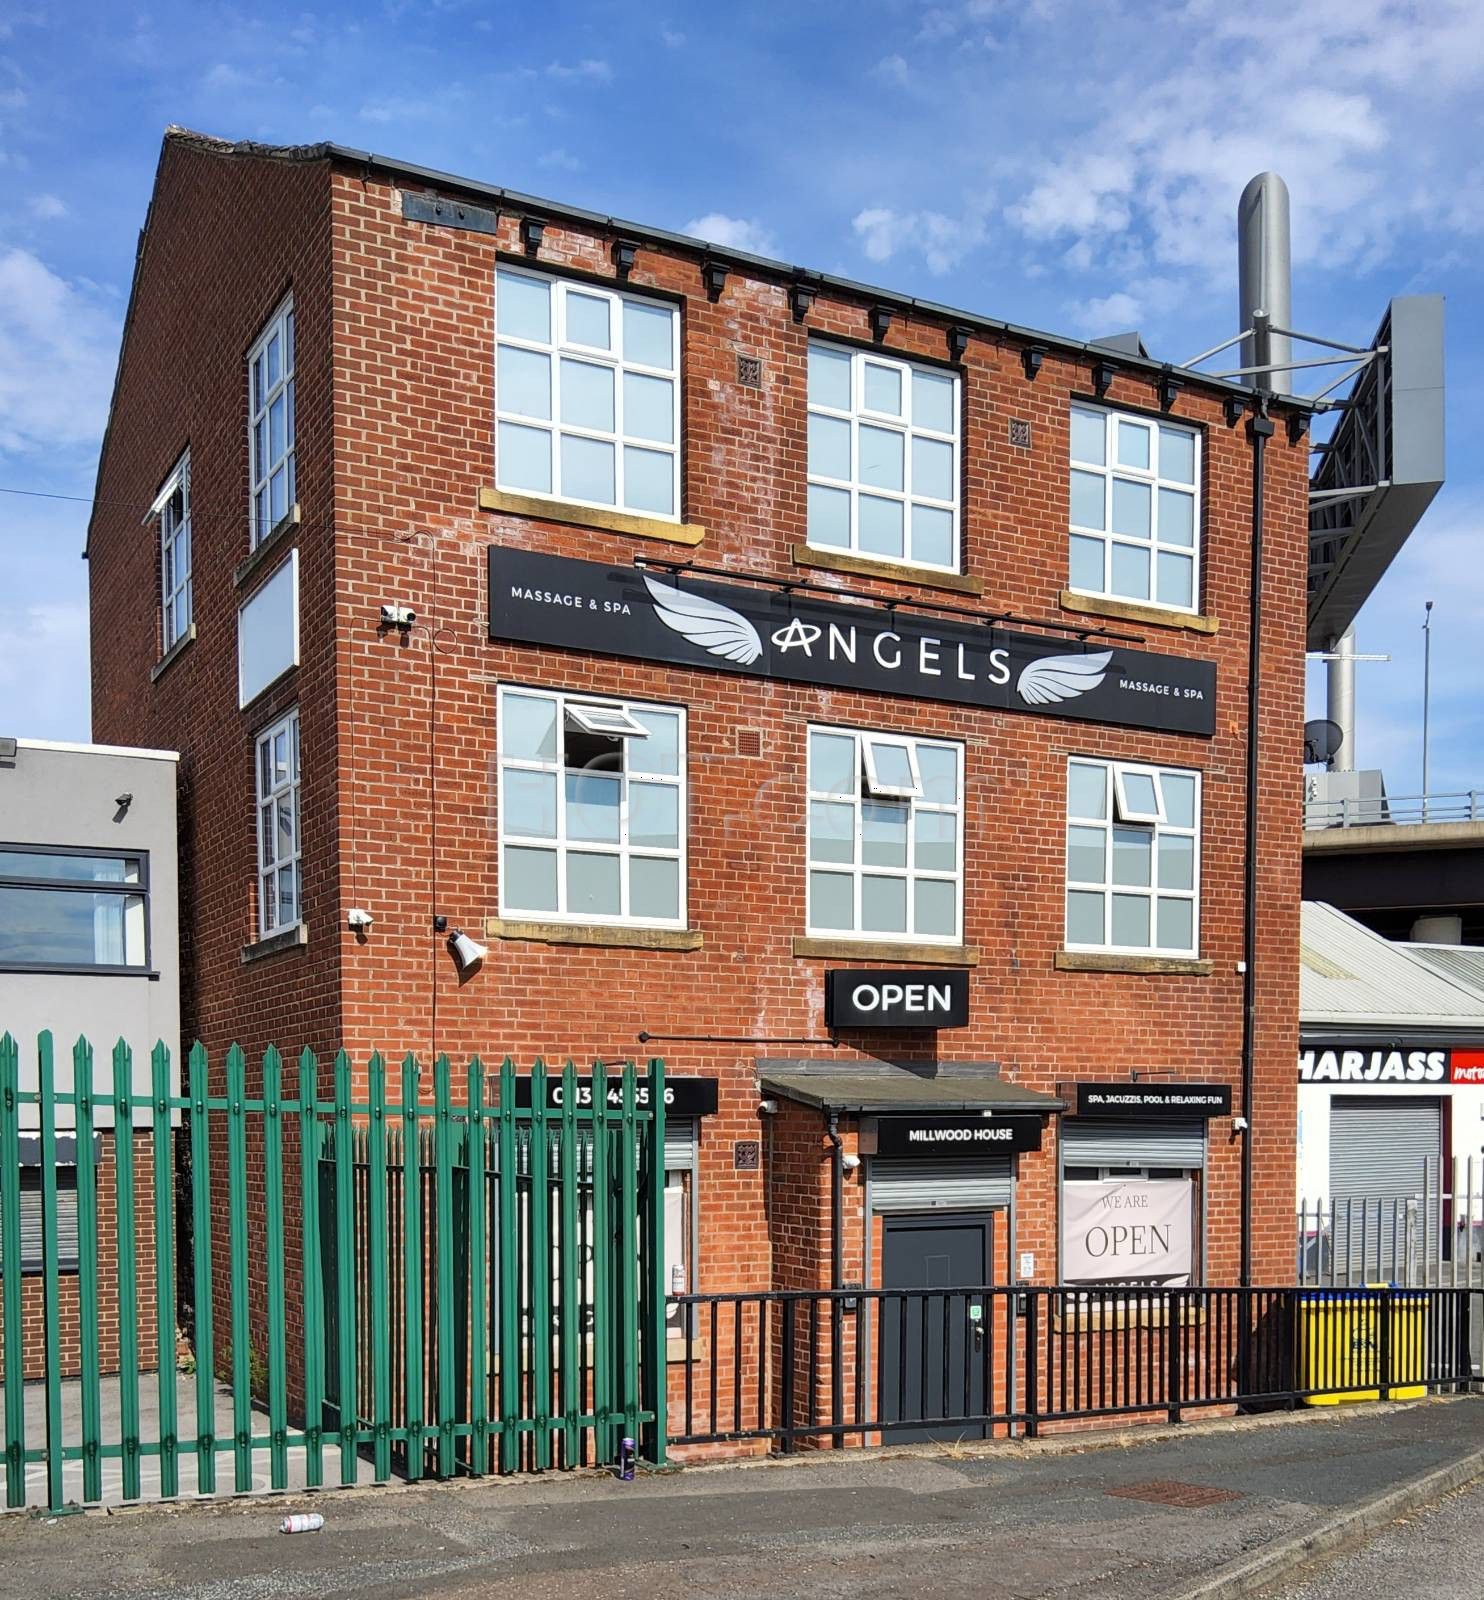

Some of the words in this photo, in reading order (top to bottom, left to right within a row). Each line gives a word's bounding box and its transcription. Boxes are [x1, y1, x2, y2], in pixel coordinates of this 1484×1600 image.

[511, 586, 583, 608] MASSAGE
[589, 599, 598, 610] &
[603, 601, 631, 615] SPA
[771, 617, 1011, 686] ANGELS
[1119, 679, 1170, 695] MASSAGE
[1173, 687, 1180, 697] &
[1183, 689, 1204, 700] SPA
[852, 984, 952, 1012] OPEN
[1297, 1050, 1446, 1081] HARJASS
[1088, 1094, 1105, 1104] SPA,
[1143, 1095, 1164, 1104] POOL
[1164, 1095, 1170, 1104] &
[1170, 1095, 1206, 1105] RELAXING
[1207, 1096, 1223, 1105] FUN
[909, 1128, 972, 1142] MILLWOOD
[973, 1128, 1014, 1141] HOUSE
[1101, 1194, 1122, 1209] WE
[1123, 1194, 1149, 1209] ARE
[1085, 1224, 1172, 1257] OPEN
